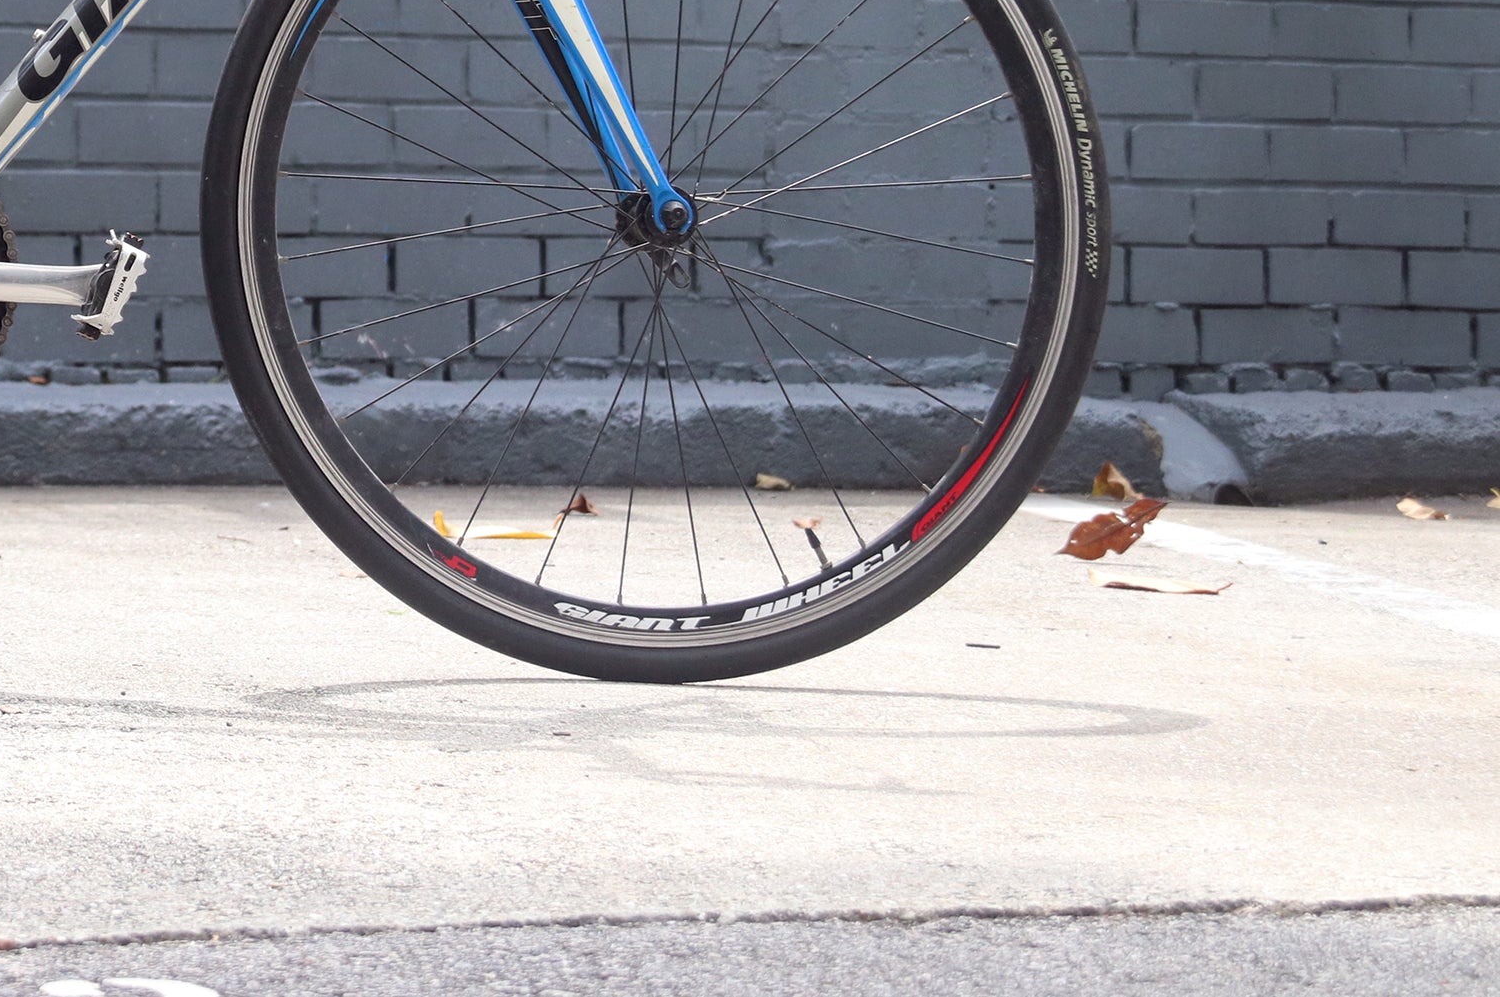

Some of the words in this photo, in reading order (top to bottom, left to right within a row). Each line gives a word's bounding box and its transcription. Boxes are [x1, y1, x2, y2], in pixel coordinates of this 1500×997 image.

[1050, 48, 1089, 134] MICHELIN
[1076, 138, 1096, 208] Dynamic
[1084, 211, 1098, 251] sport
[113, 276, 128, 302] wellgo
[553, 601, 711, 631] GIANT
[740, 539, 911, 622] WHEEL
